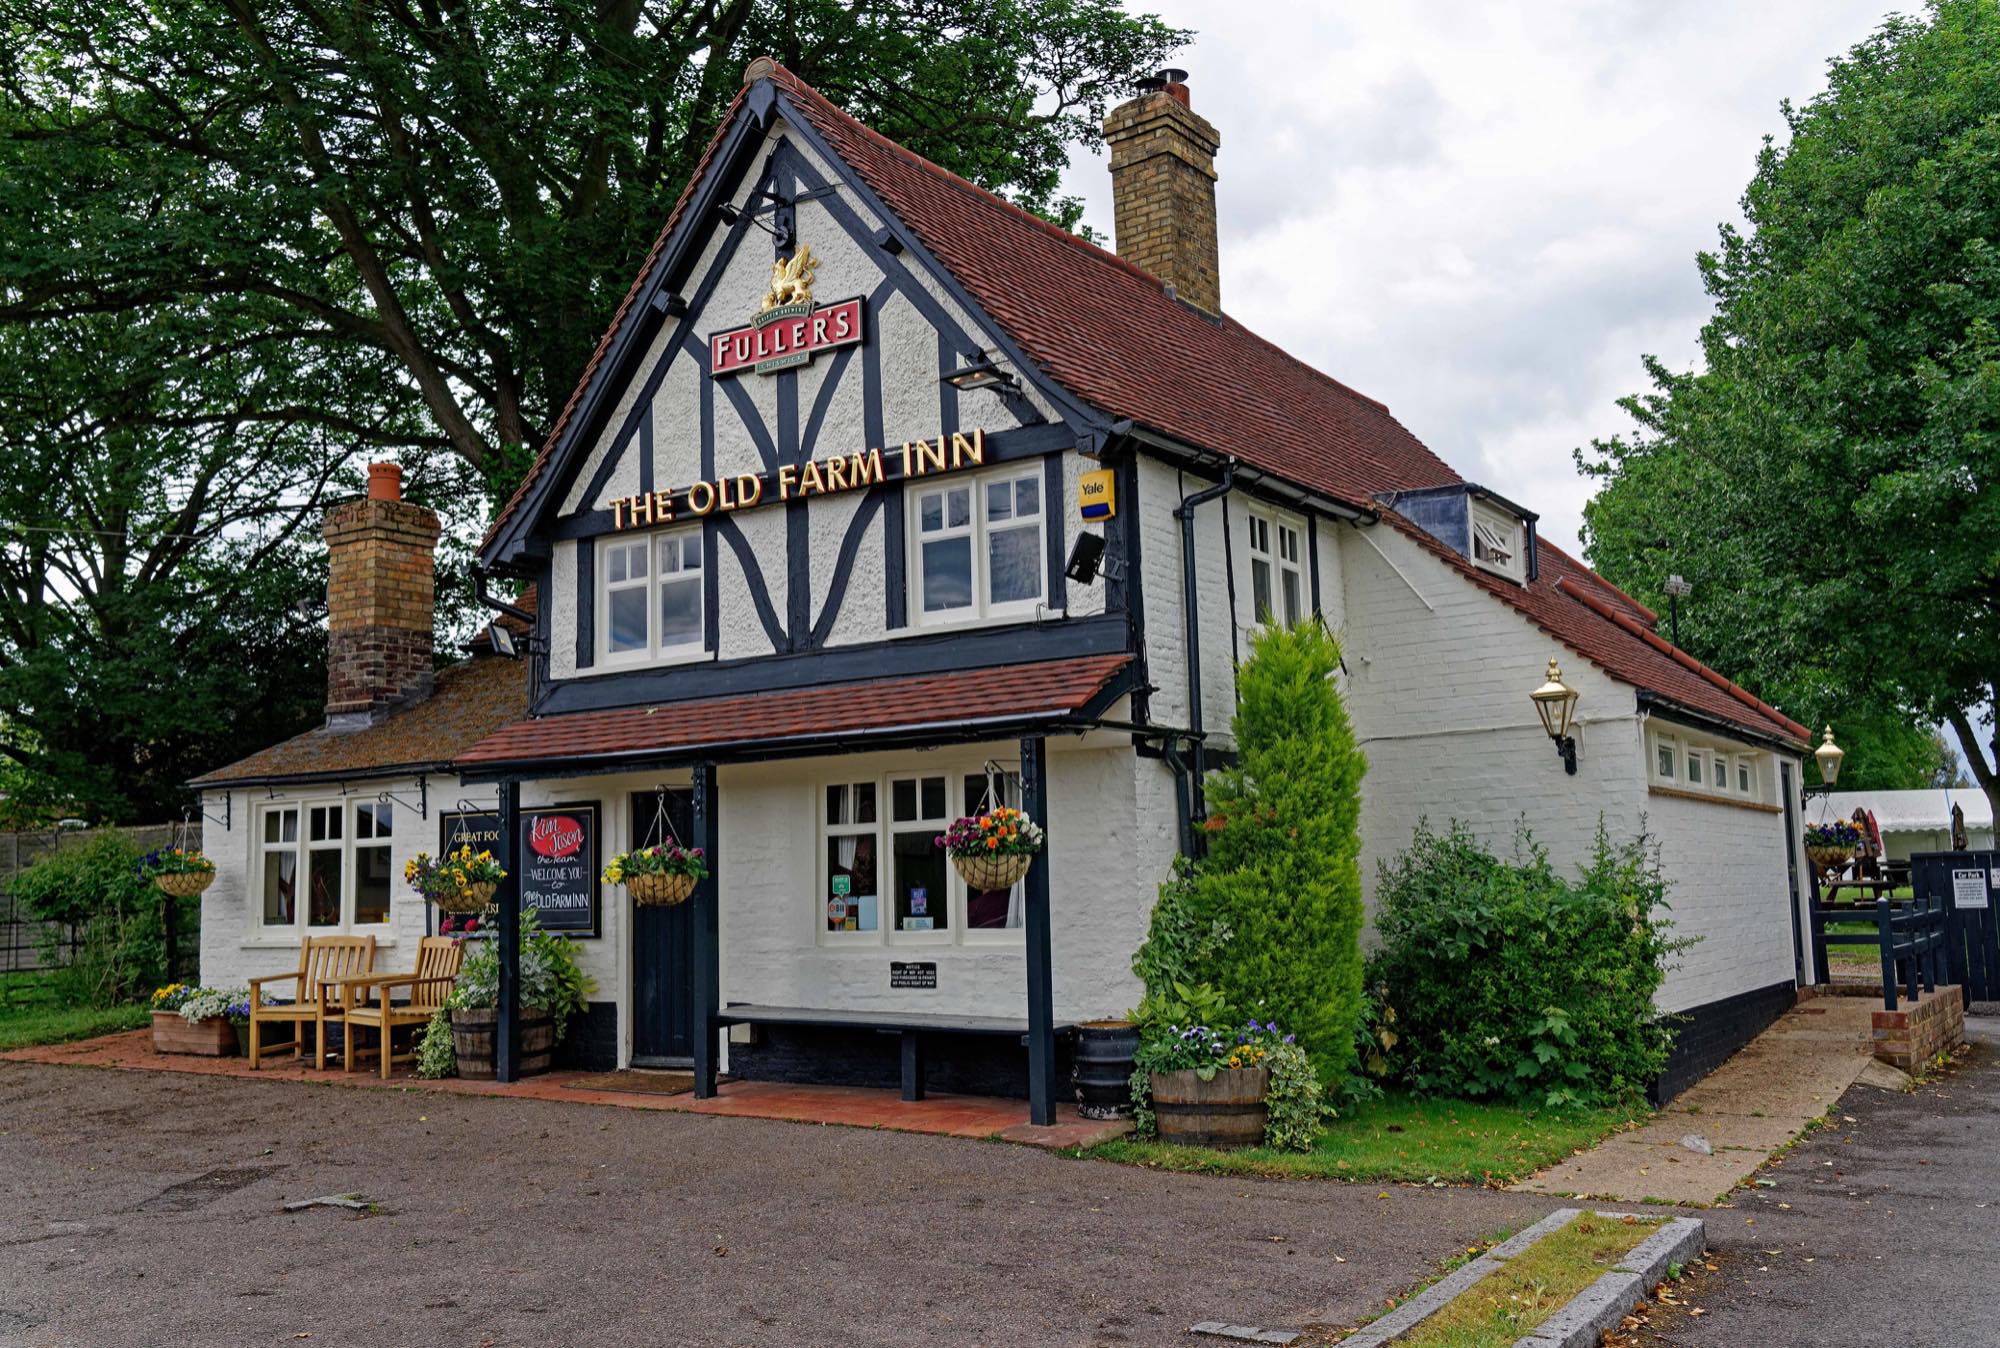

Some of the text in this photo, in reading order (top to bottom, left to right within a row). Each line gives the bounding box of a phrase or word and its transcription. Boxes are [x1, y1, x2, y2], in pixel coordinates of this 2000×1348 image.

[717, 309, 850, 366] FULLER'S
[609, 427, 986, 530] THE OLD FARM INN
[1082, 482, 1104, 495] Yale
[454, 830, 500, 843] GREAT FOO
[531, 866, 583, 880] WELCOME YOU
[536, 893, 552, 909] OLD
[552, 893, 572, 909] FARM
[572, 892, 589, 908] INN
